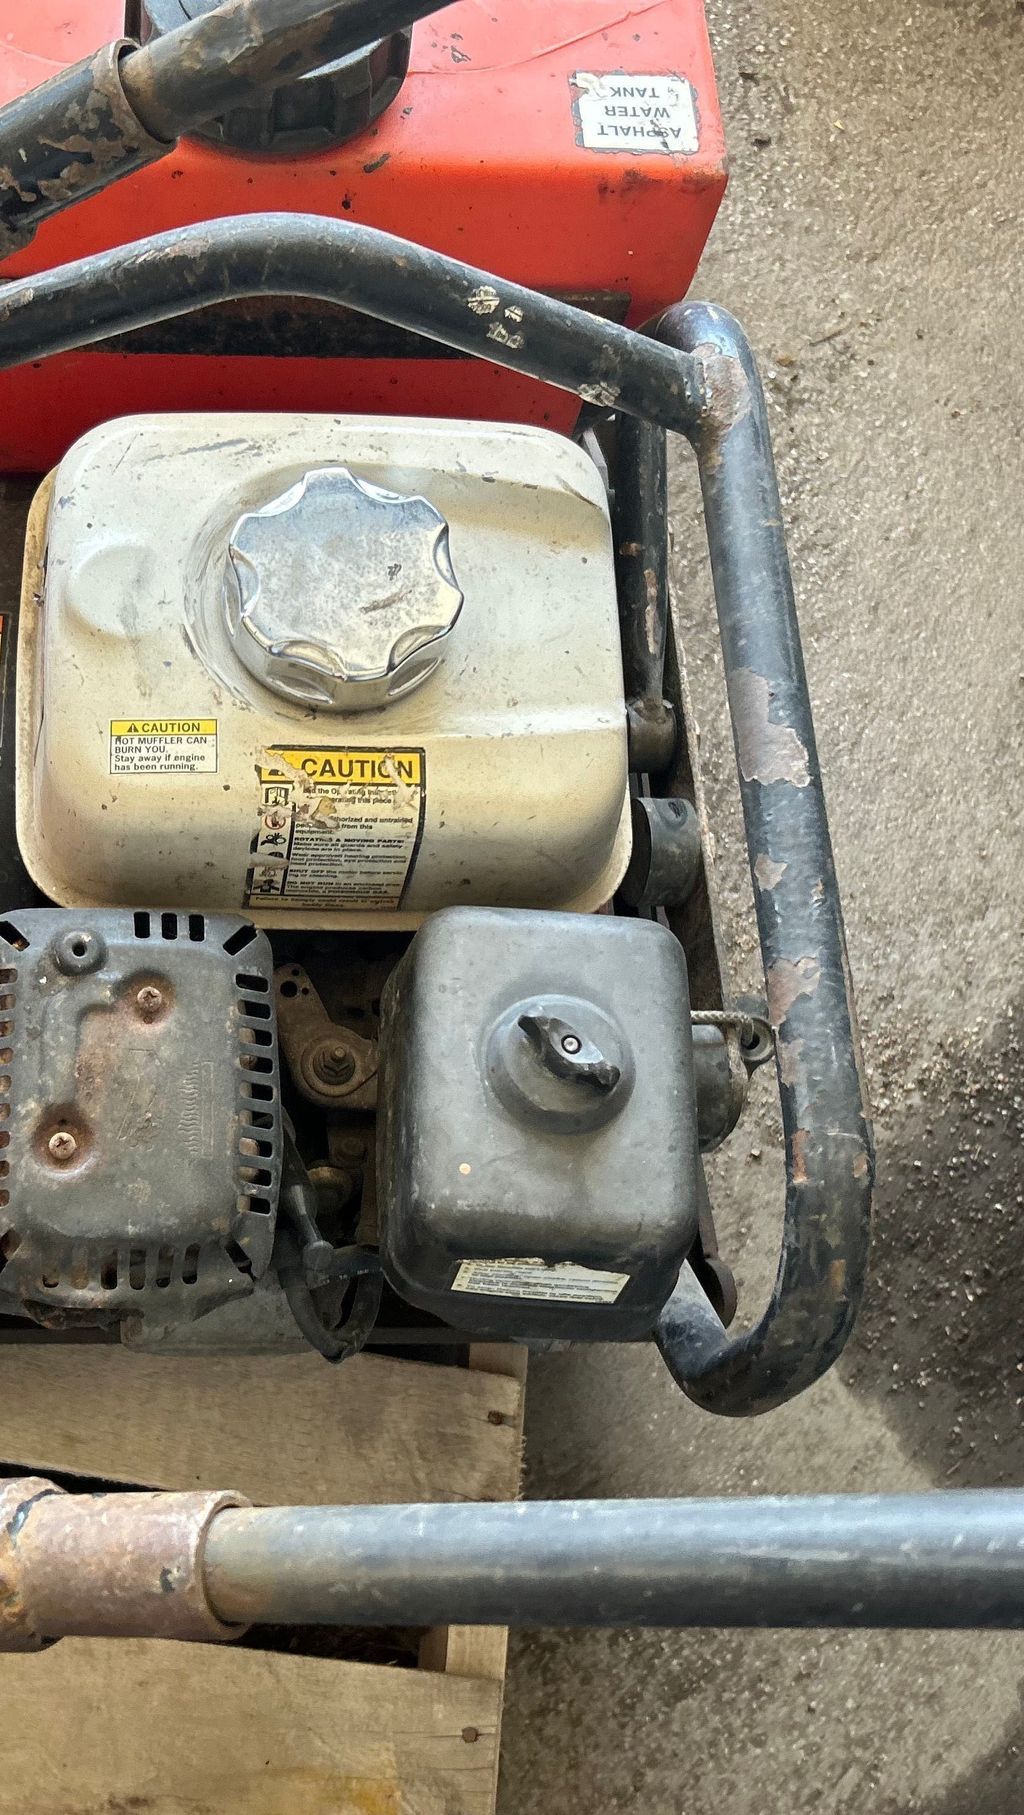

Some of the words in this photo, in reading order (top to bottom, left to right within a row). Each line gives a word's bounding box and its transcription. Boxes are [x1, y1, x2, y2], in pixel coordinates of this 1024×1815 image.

[609, 87, 660, 98] TANK
[604, 105, 670, 118] WATER
[597, 125, 682, 138] ASPHALT
[142, 722, 200, 732] CAUTION
[115, 737, 135, 745] HOT
[187, 736, 207, 744] CAN
[115, 755, 135, 763] Stay
[138, 755, 161, 763] away
[174, 754, 205, 762] engine
[114, 763, 131, 771] has
[160, 763, 198, 772] running.
[301, 758, 413, 778] CAUTION
